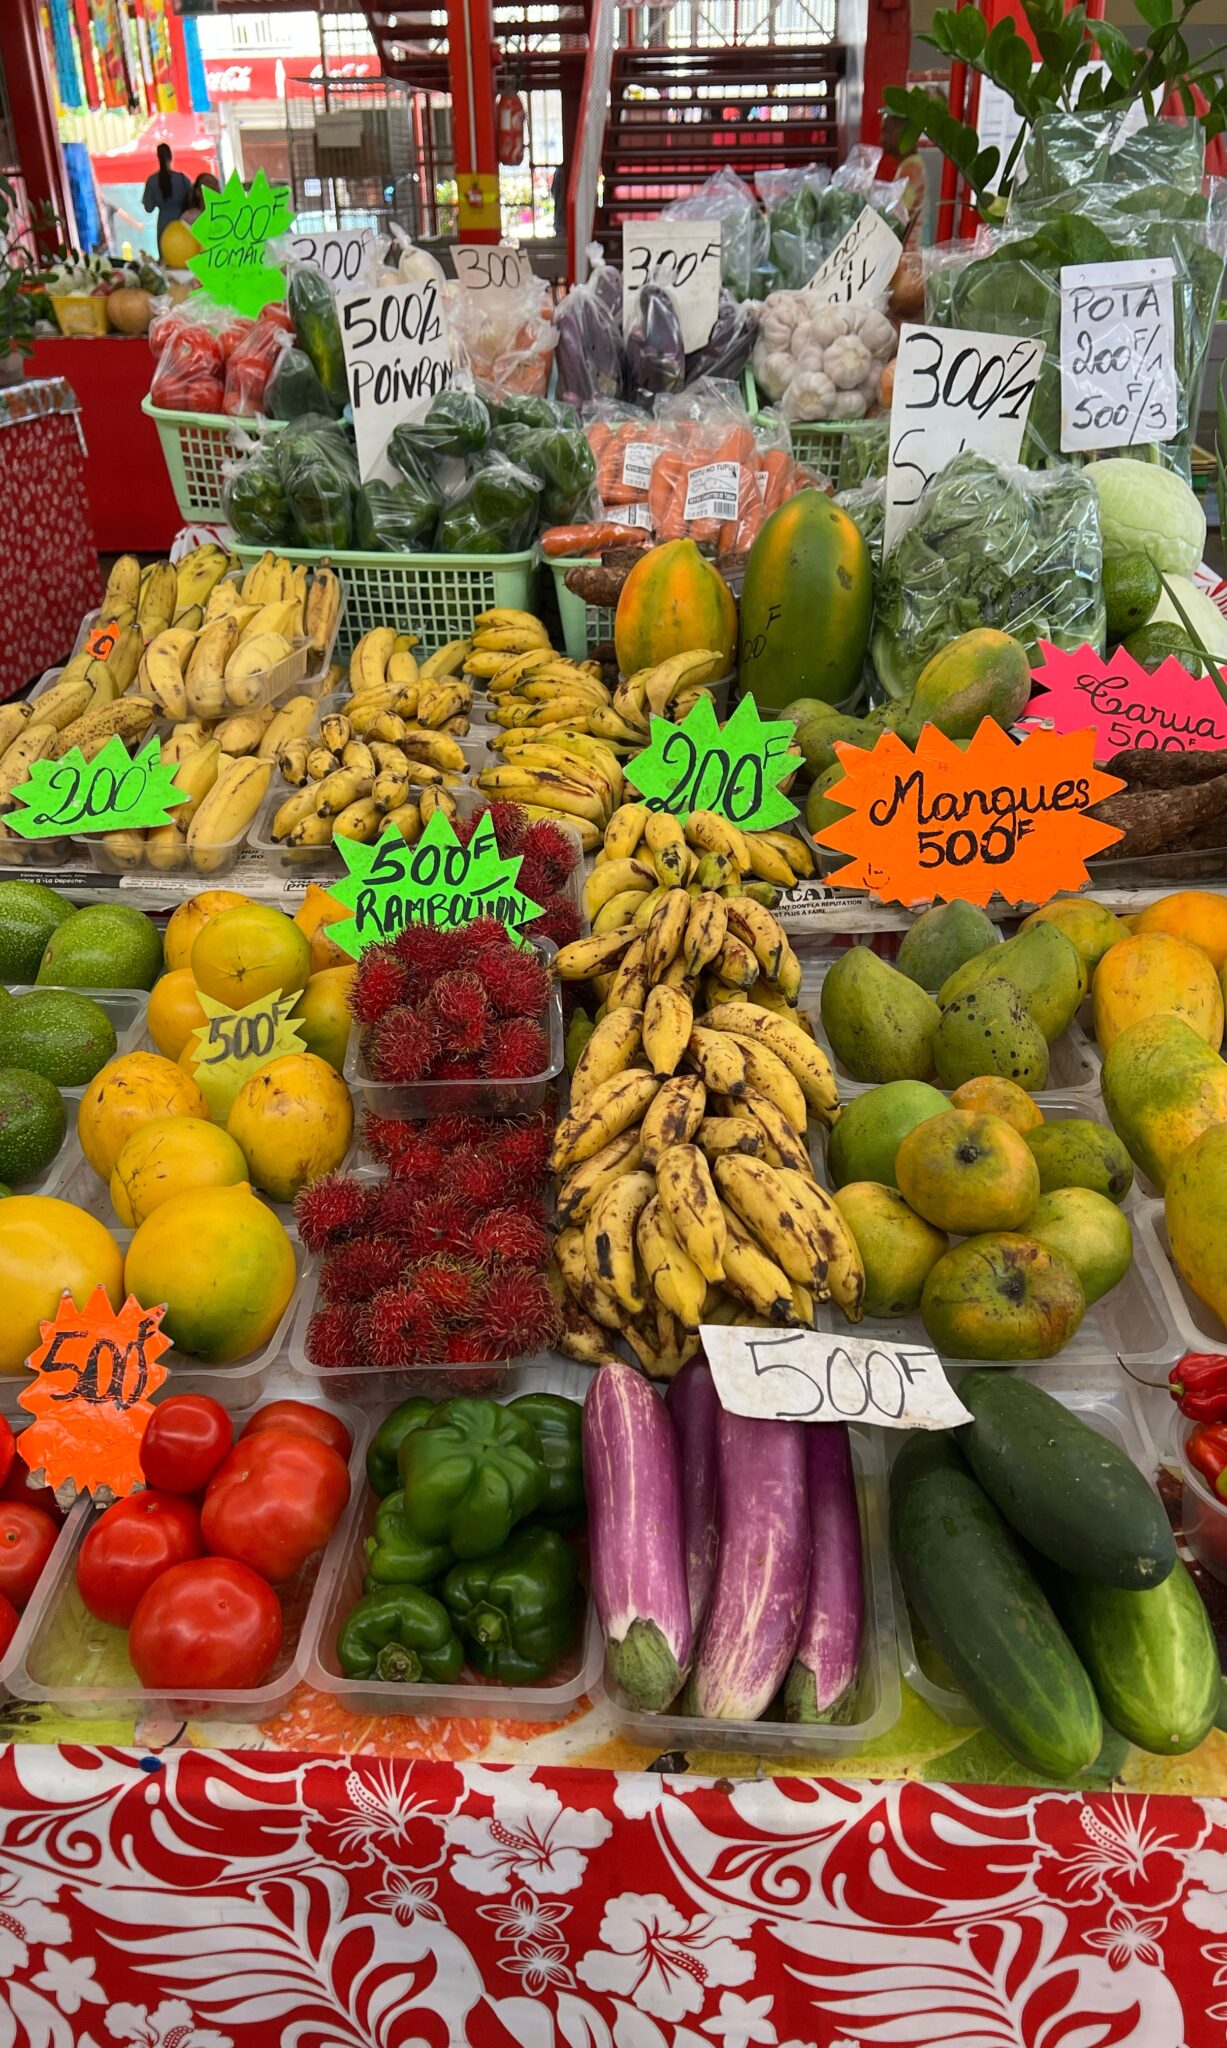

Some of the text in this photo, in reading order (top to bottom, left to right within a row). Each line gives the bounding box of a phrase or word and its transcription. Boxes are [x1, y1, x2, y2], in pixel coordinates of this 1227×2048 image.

[207, 191, 289, 242] 500F
[458, 249, 528, 289] 300F
[628, 243, 721, 290] 300F
[1069, 284, 1160, 323] POTA
[1073, 674, 1226, 740] Carua
[33, 753, 161, 825] 200F
[645, 731, 789, 822] 200F
[868, 769, 1090, 833] Mangues
[361, 832, 496, 886] 500F
[917, 817, 1036, 868] 500F
[205, 998, 295, 1065] 500F
[745, 1333, 938, 1419] 500F
